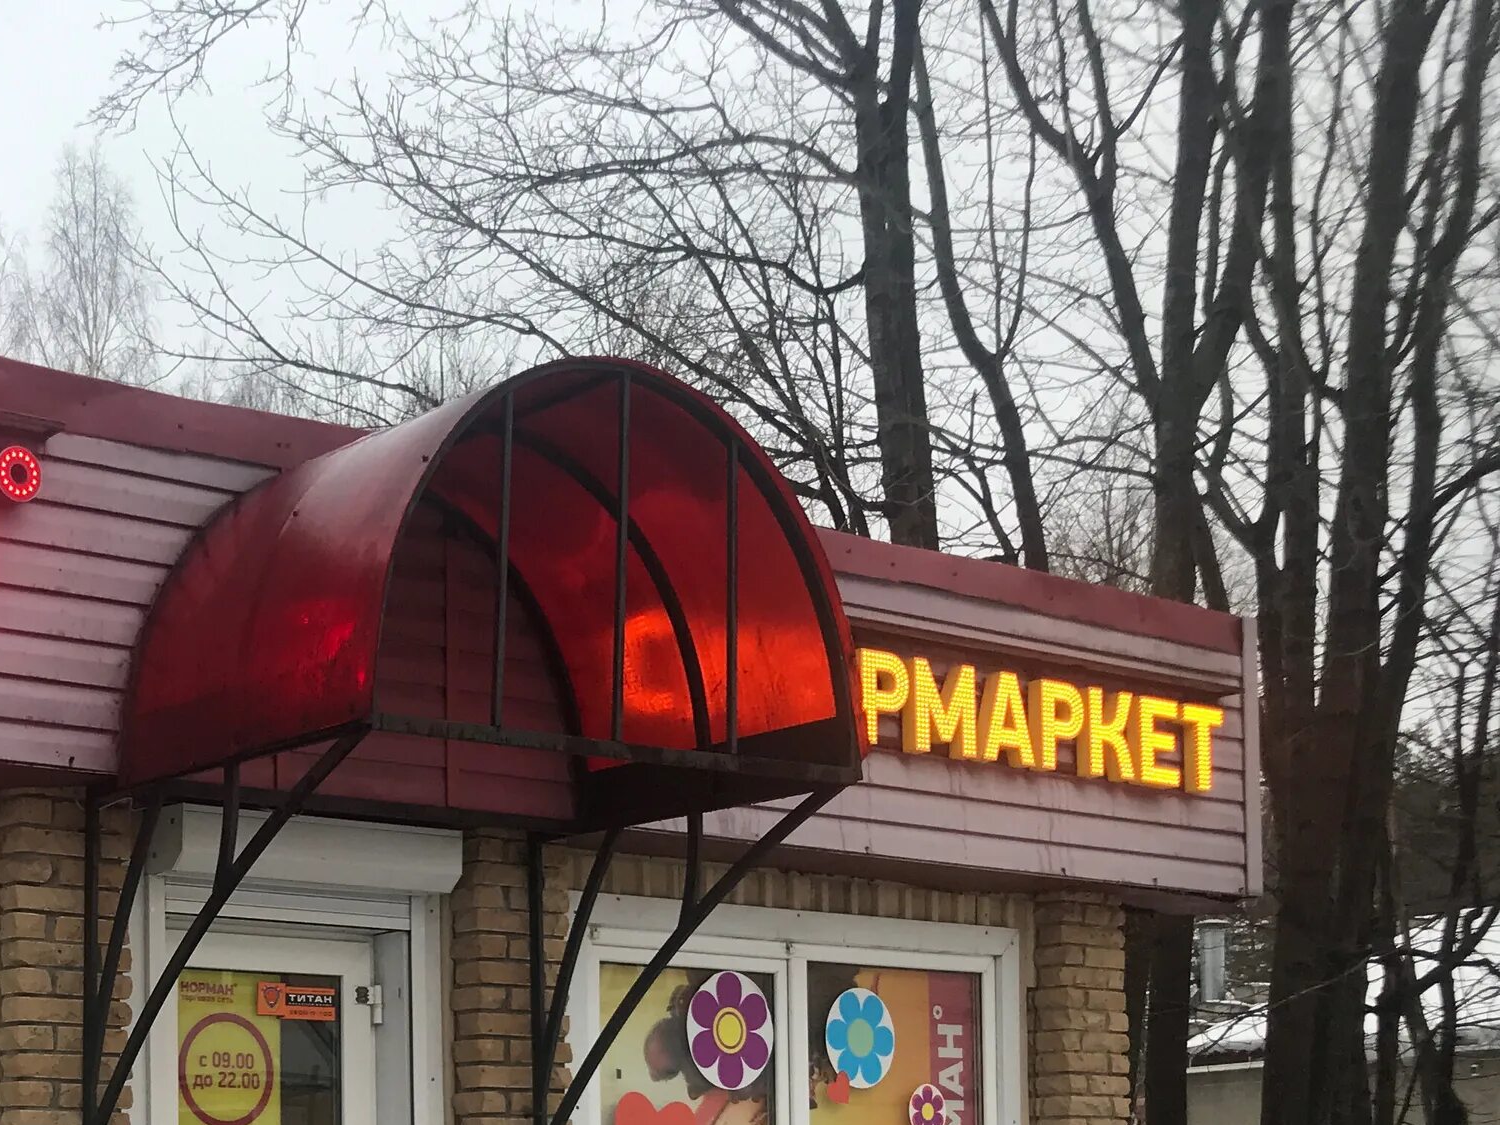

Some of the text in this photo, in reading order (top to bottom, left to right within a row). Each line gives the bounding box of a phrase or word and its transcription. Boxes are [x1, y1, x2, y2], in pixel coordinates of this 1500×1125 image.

[288, 994, 332, 1004] ТИТАН
[200, 1051, 254, 1069] с 09.00
[193, 1072, 260, 1090] до 22.00
